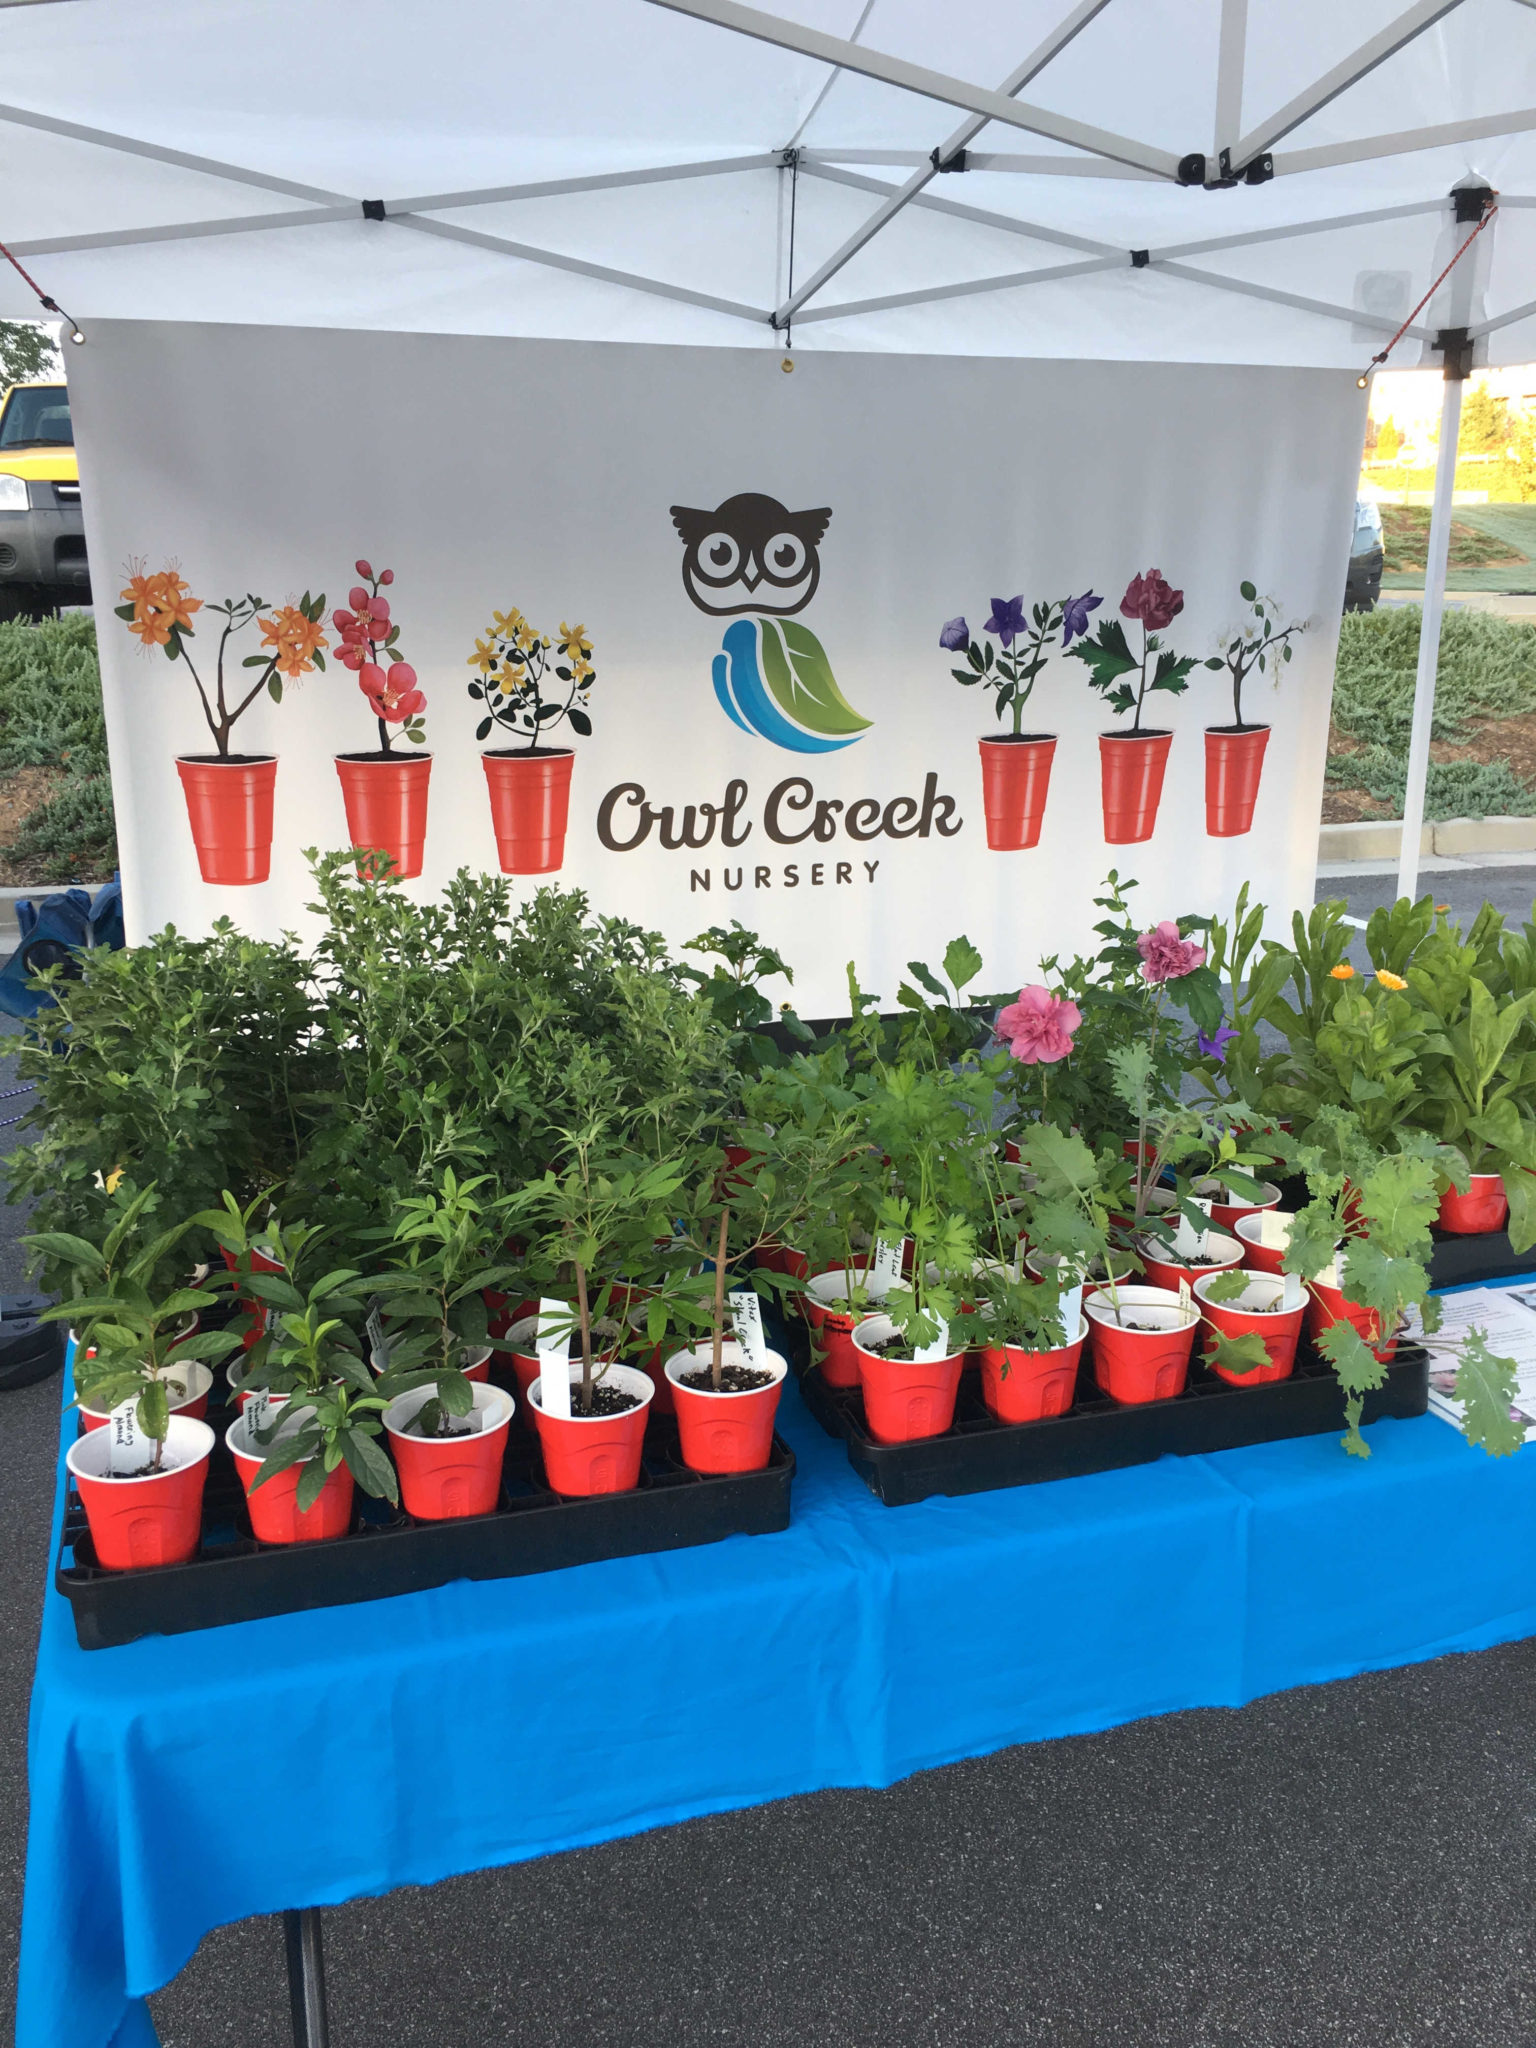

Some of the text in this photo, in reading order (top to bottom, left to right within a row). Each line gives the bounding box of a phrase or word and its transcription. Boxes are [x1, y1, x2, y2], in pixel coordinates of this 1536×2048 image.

[597, 772, 963, 852] Owl Creek
[690, 860, 880, 892] NURSERY
[878, 1240, 889, 1264] arsley
[747, 1297, 757, 1323] Vitex
[124, 1406, 135, 1446] Flowering
